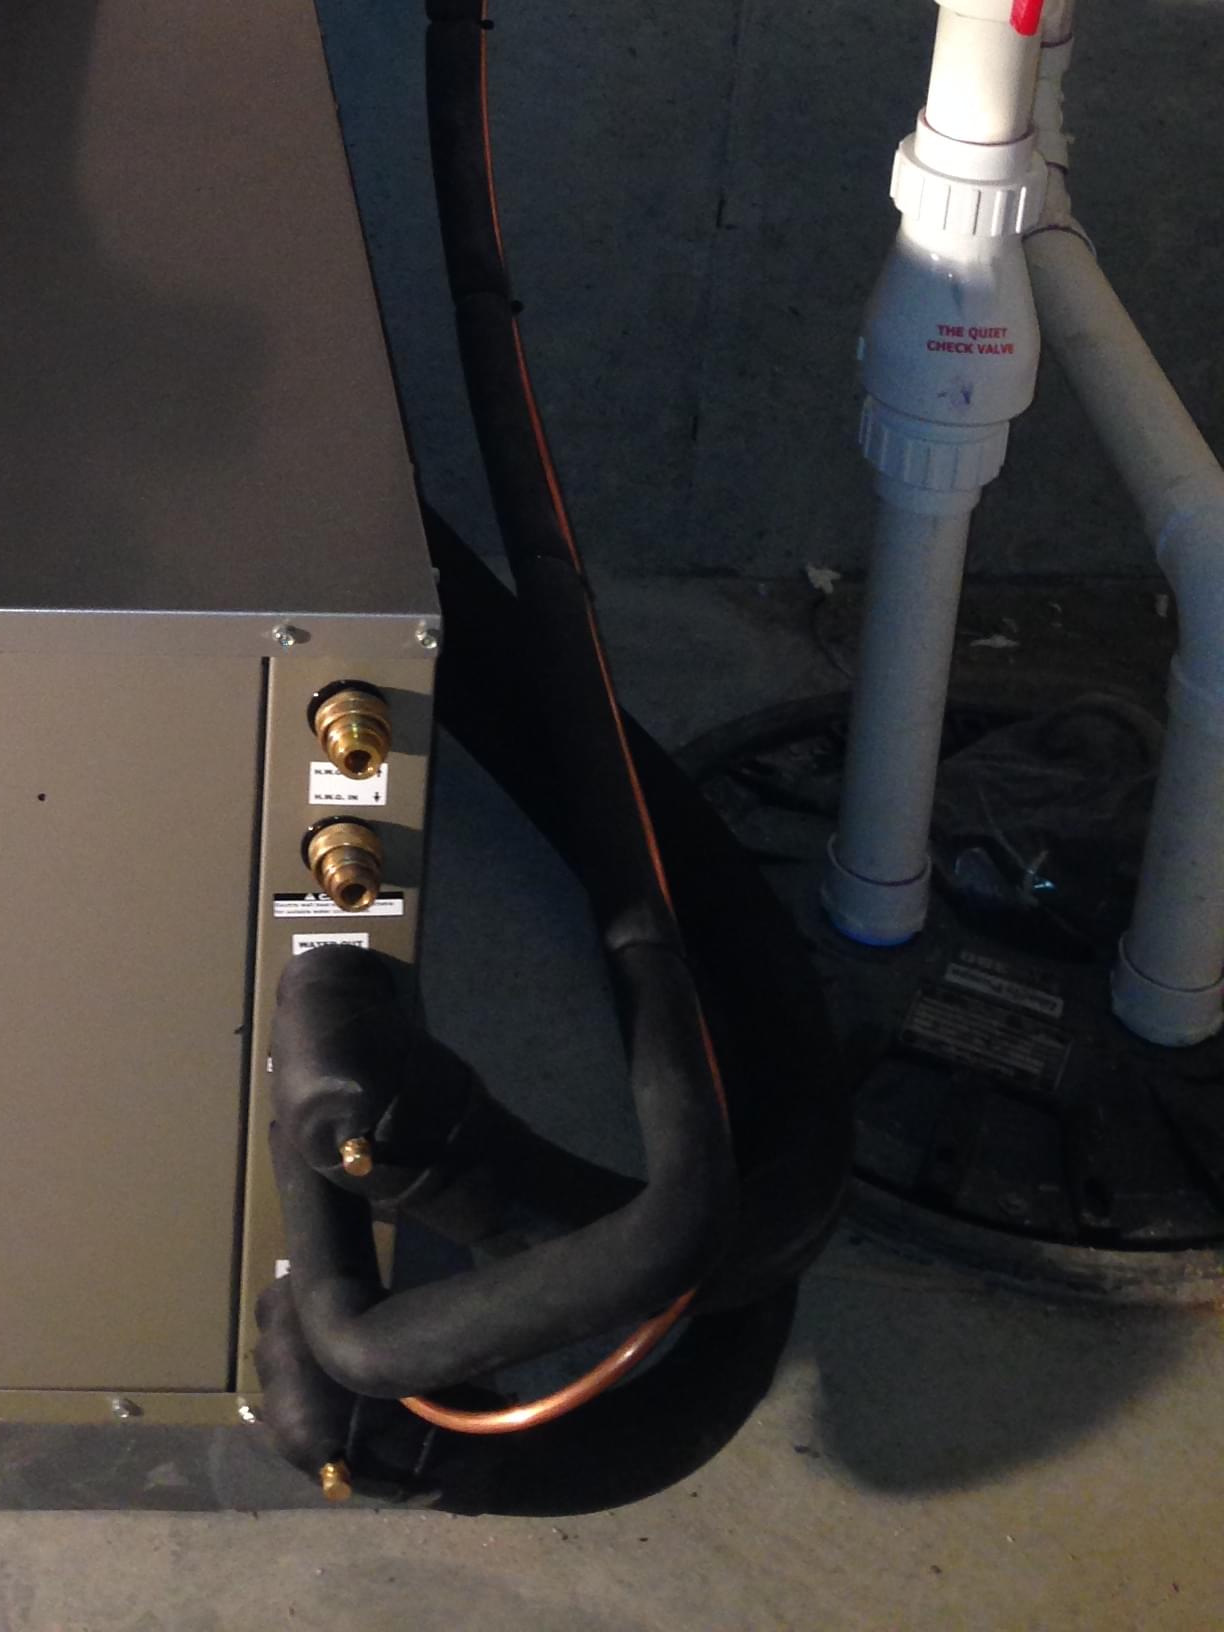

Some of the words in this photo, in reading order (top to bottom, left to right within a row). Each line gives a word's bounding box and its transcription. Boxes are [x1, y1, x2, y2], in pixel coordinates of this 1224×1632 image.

[936, 324, 964, 337] THE
[968, 327, 1008, 340] QUIET
[926, 340, 973, 353] CHECK
[977, 344, 1015, 354] VALVE
